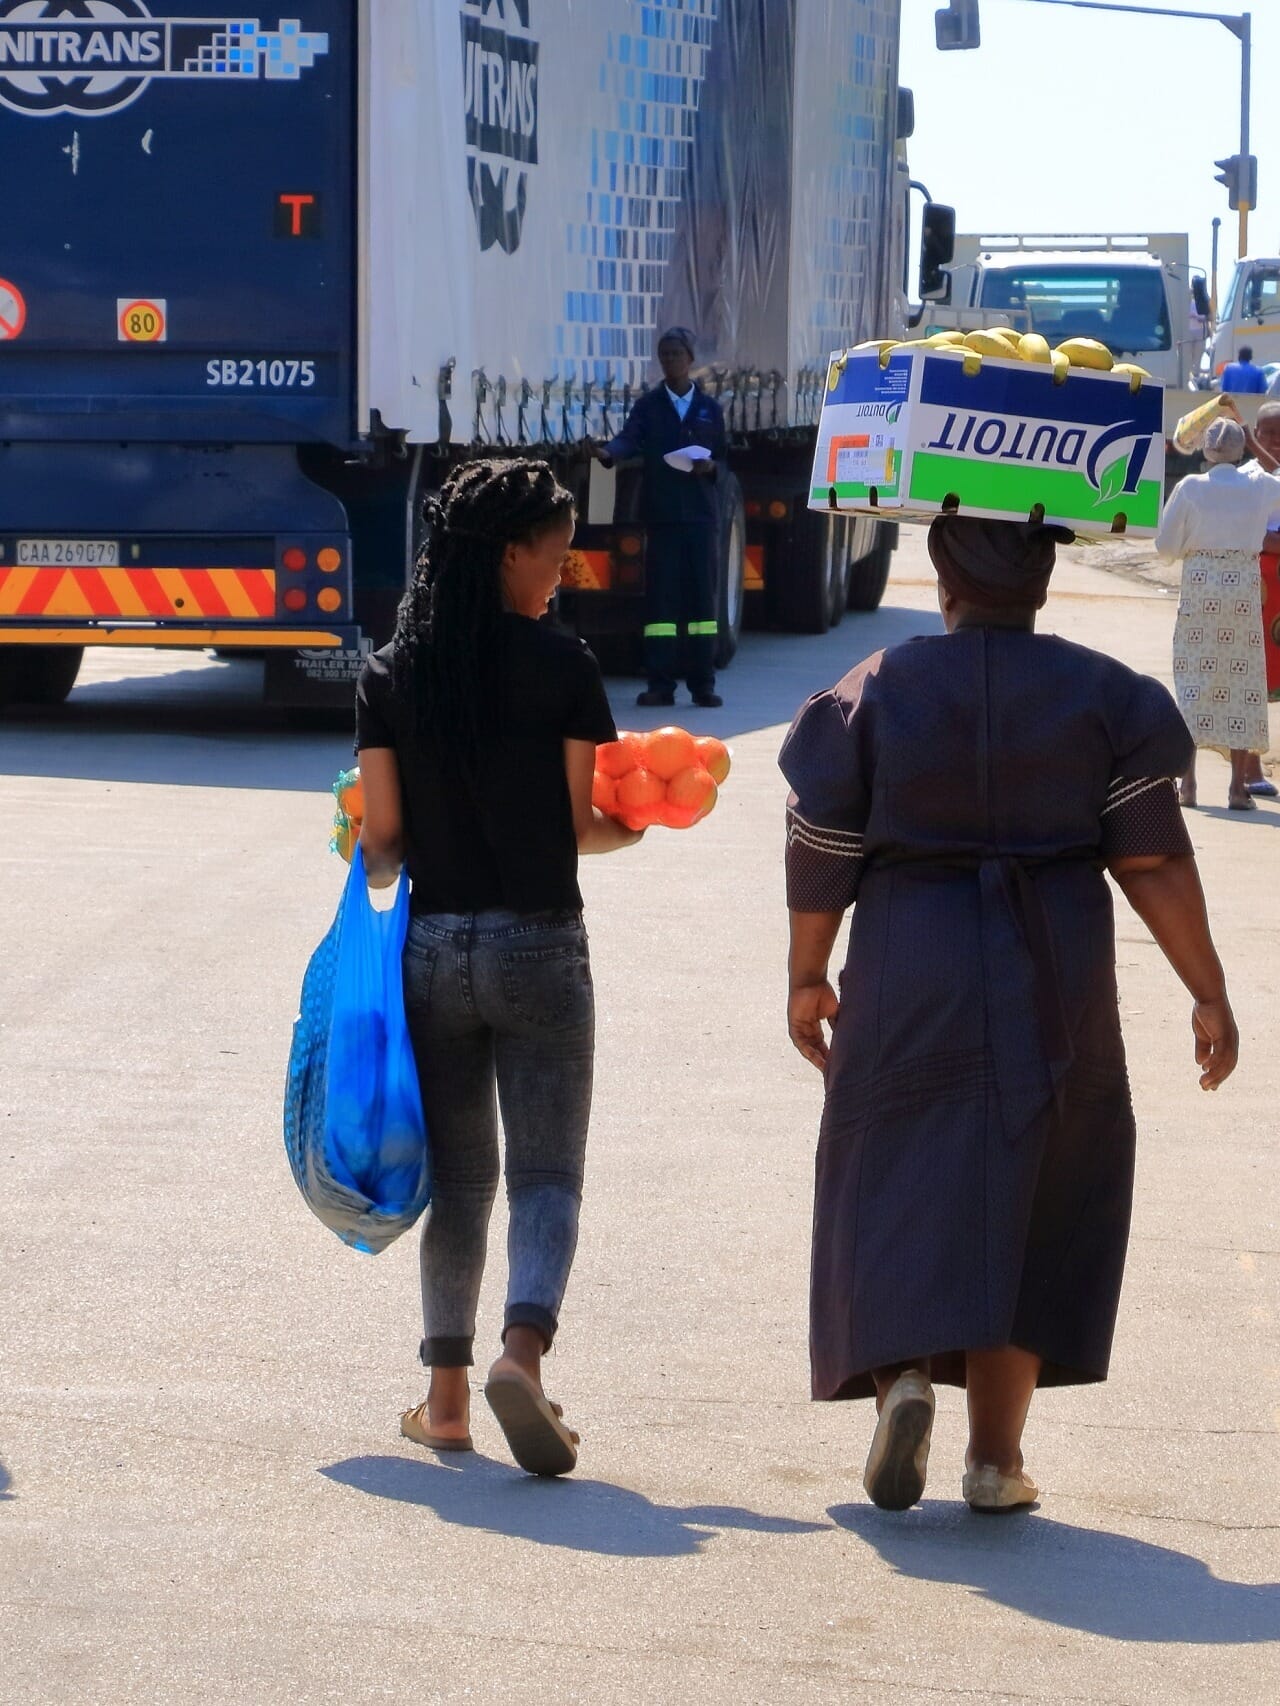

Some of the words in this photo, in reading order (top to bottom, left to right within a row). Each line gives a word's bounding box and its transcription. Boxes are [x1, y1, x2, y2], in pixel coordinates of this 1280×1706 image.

[279, 195, 314, 235] T
[130, 313, 155, 334] 80
[206, 360, 315, 386] SB21075
[928, 413, 1087, 466] DUTOIT
[20, 543, 49, 562] CAA
[294, 659, 345, 669] TRAILER
